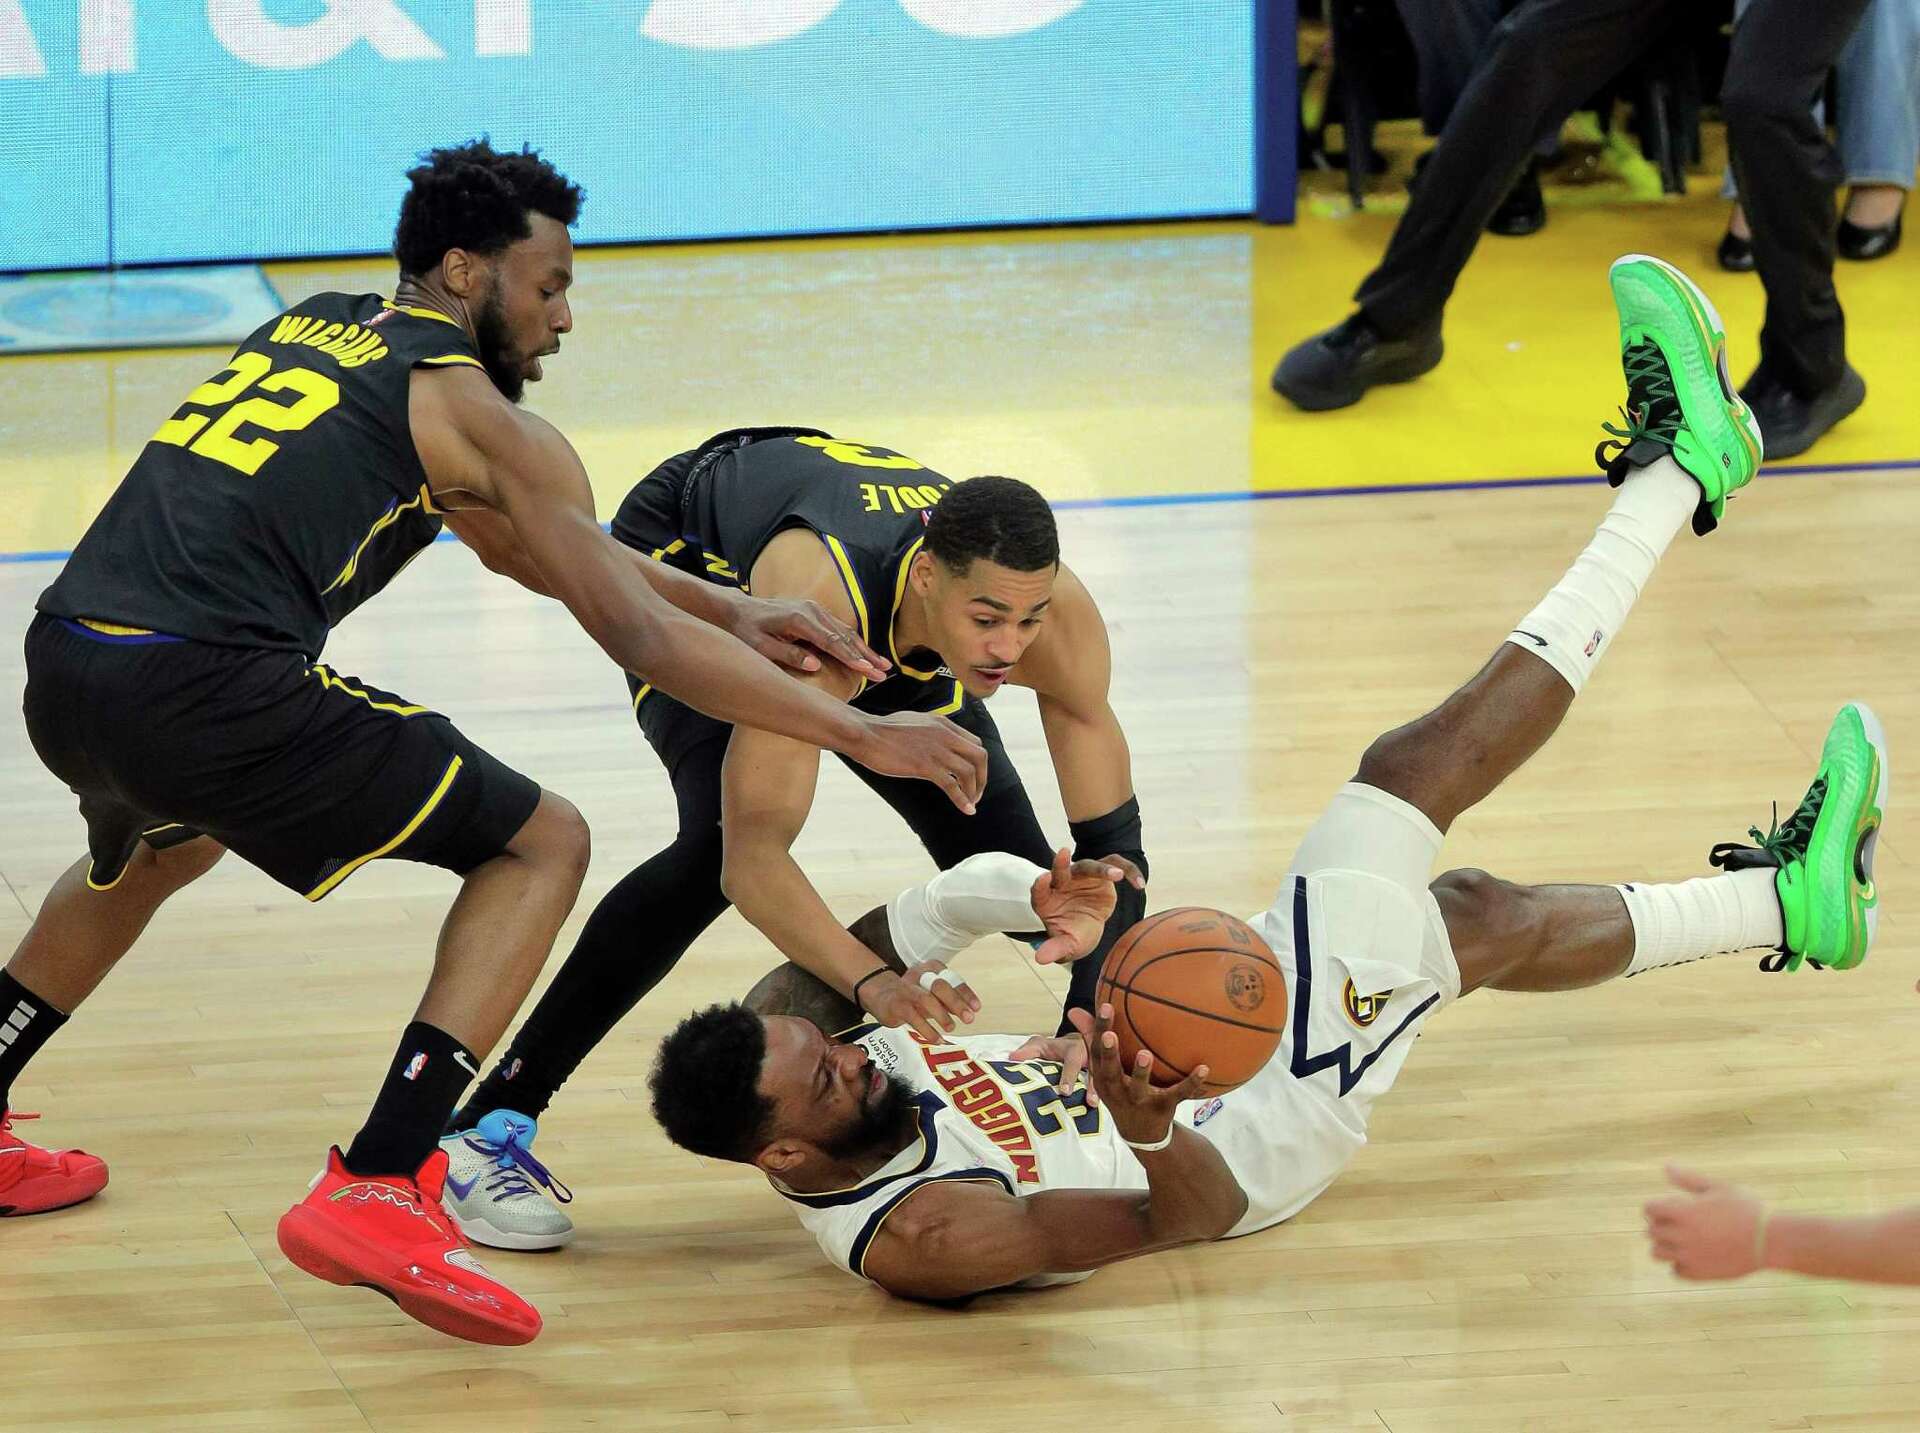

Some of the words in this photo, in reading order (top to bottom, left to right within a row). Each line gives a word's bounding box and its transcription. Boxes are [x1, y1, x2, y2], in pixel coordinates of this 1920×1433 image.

[269, 315, 390, 368] WIGGINS
[150, 351, 340, 476] 22
[858, 482, 950, 514] OOLE
[868, 1035, 896, 1074] Western
[878, 1036, 899, 1069] Union
